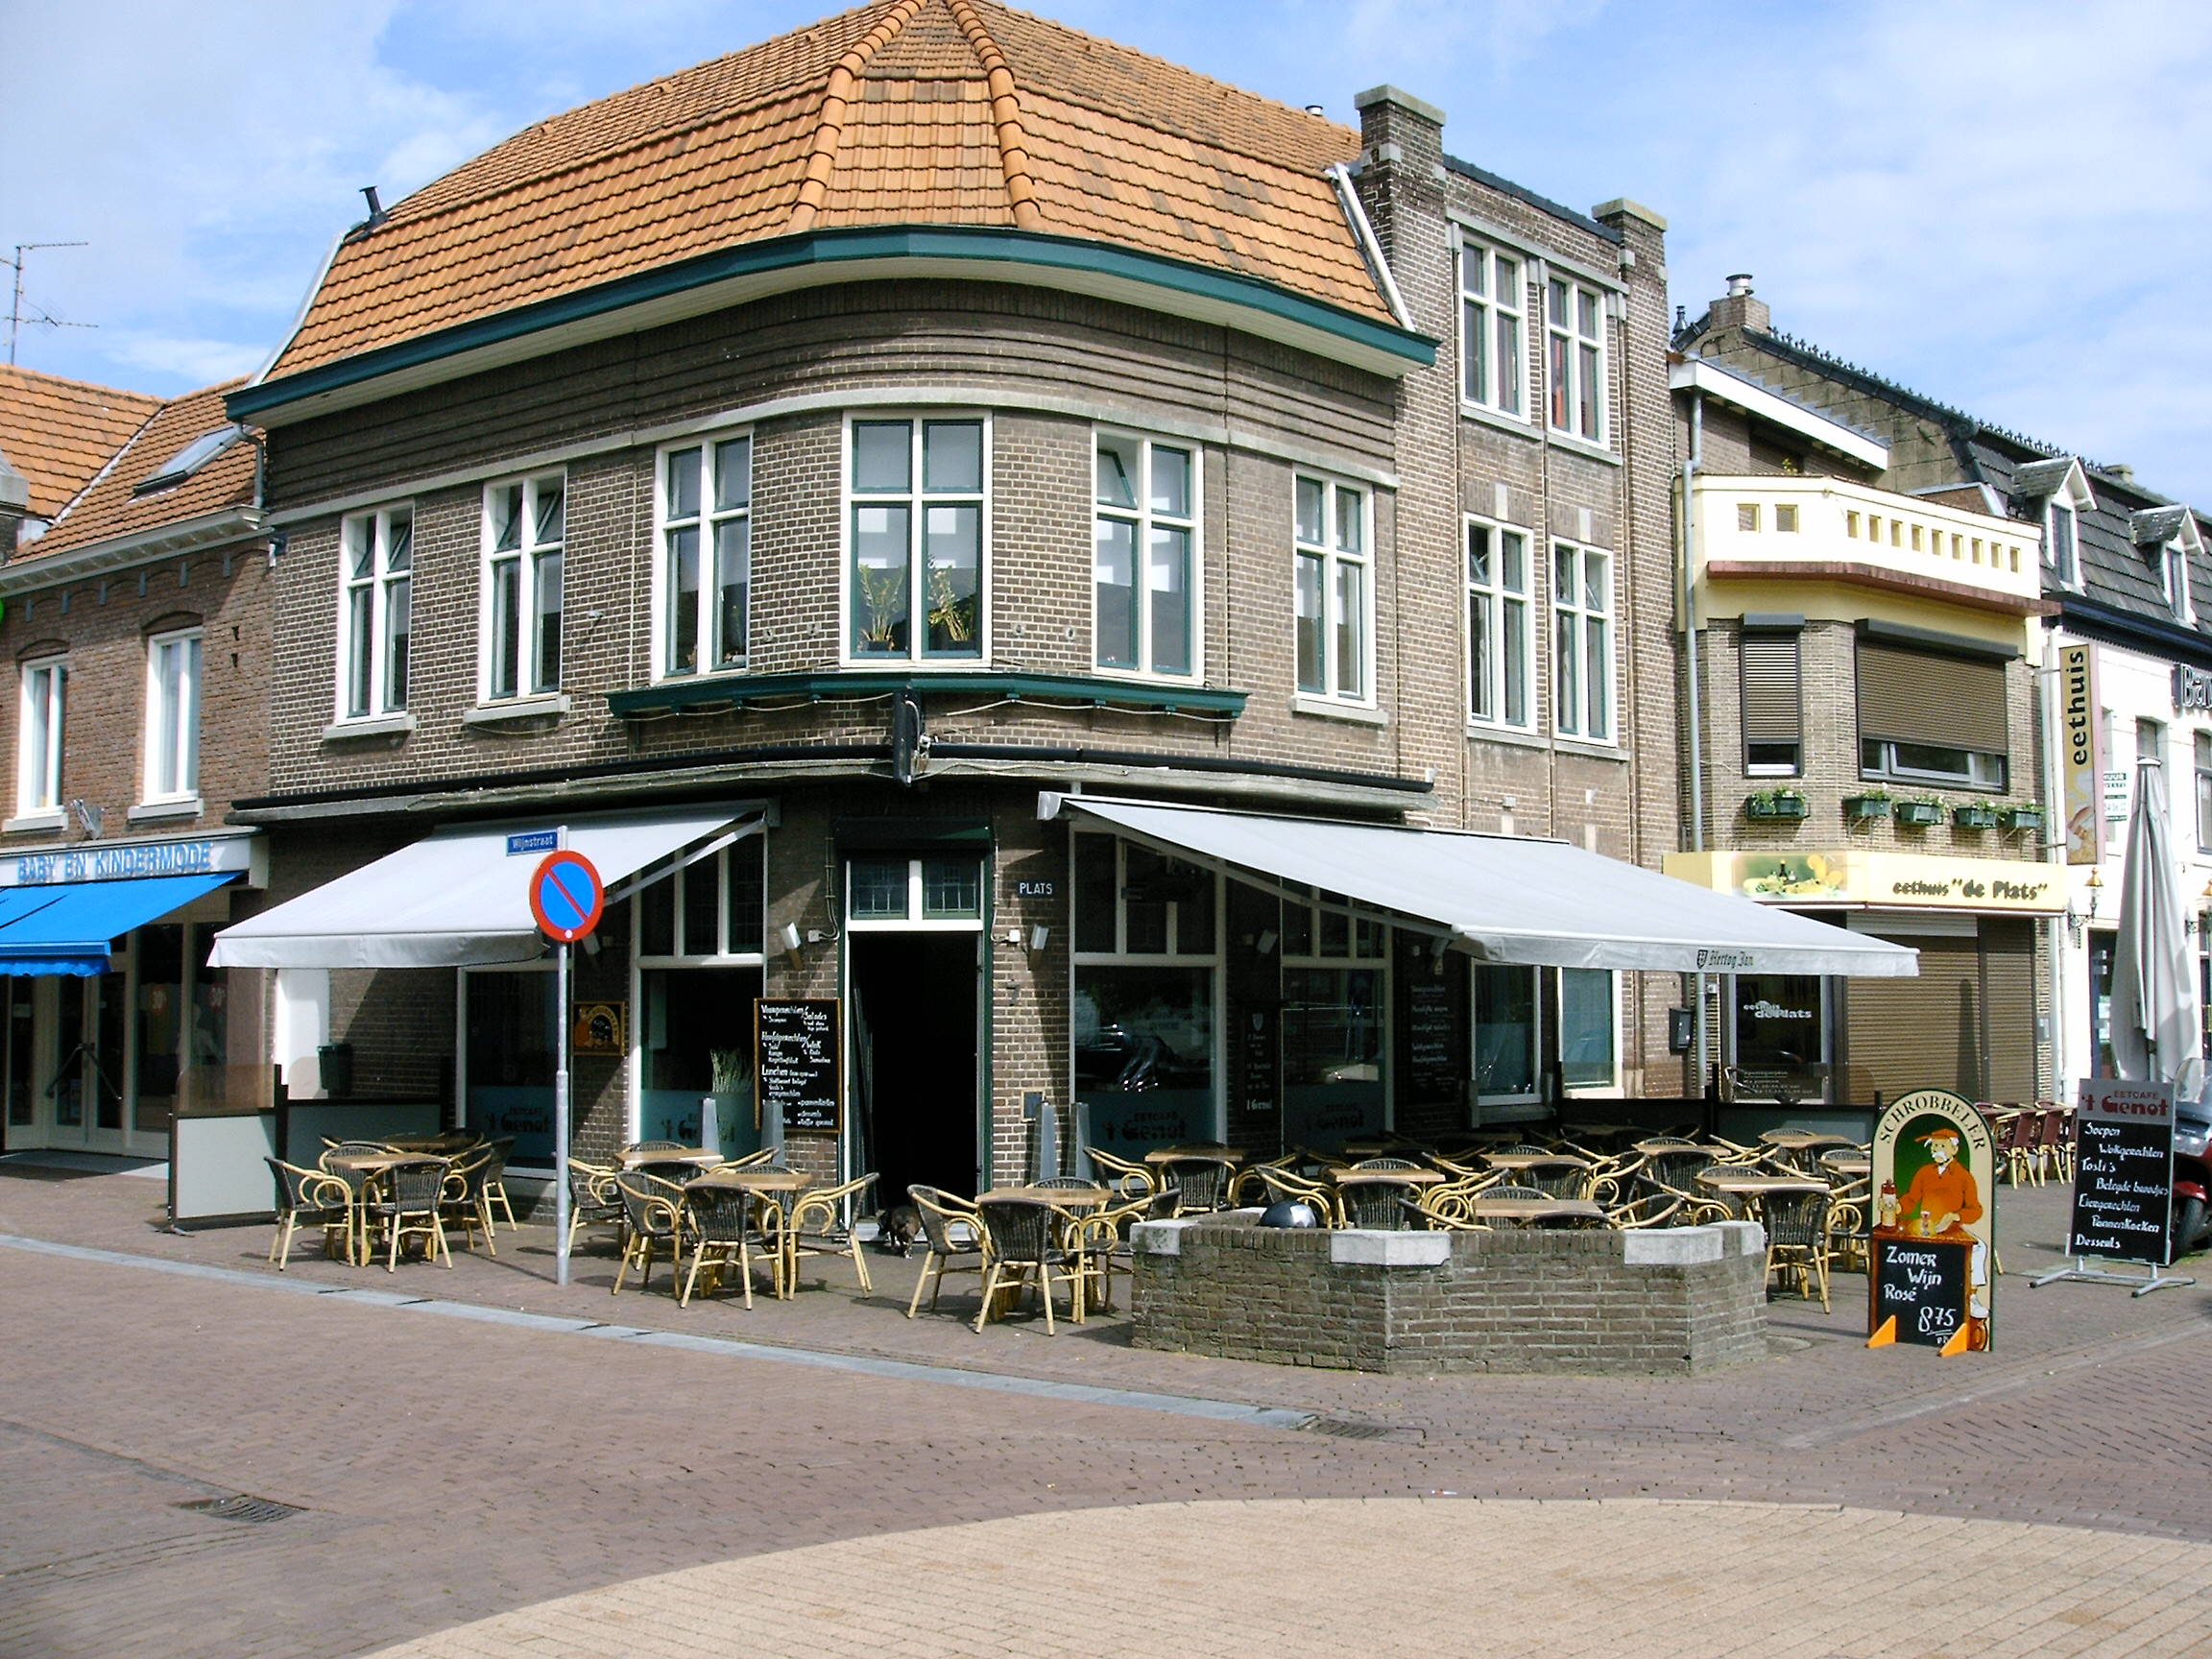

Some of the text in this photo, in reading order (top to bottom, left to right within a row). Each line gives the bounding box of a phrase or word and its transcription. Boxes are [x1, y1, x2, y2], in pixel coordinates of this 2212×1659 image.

[2066, 650, 2087, 765] eethuis
[512, 834, 553, 851] Wijnstraat
[18, 842, 213, 880] BABY EN KINDERMODE
[1020, 882, 1053, 894] PLATS
[1892, 880, 1949, 897] eethuis
[2102, 1095, 2168, 1116] Genot
[1880, 1095, 1985, 1149] SCHROBBELER
[2084, 1121, 2121, 1138] Soepen
[1907, 1267, 1942, 1289] Wijn
[1884, 1284, 1917, 1301] Rosé
